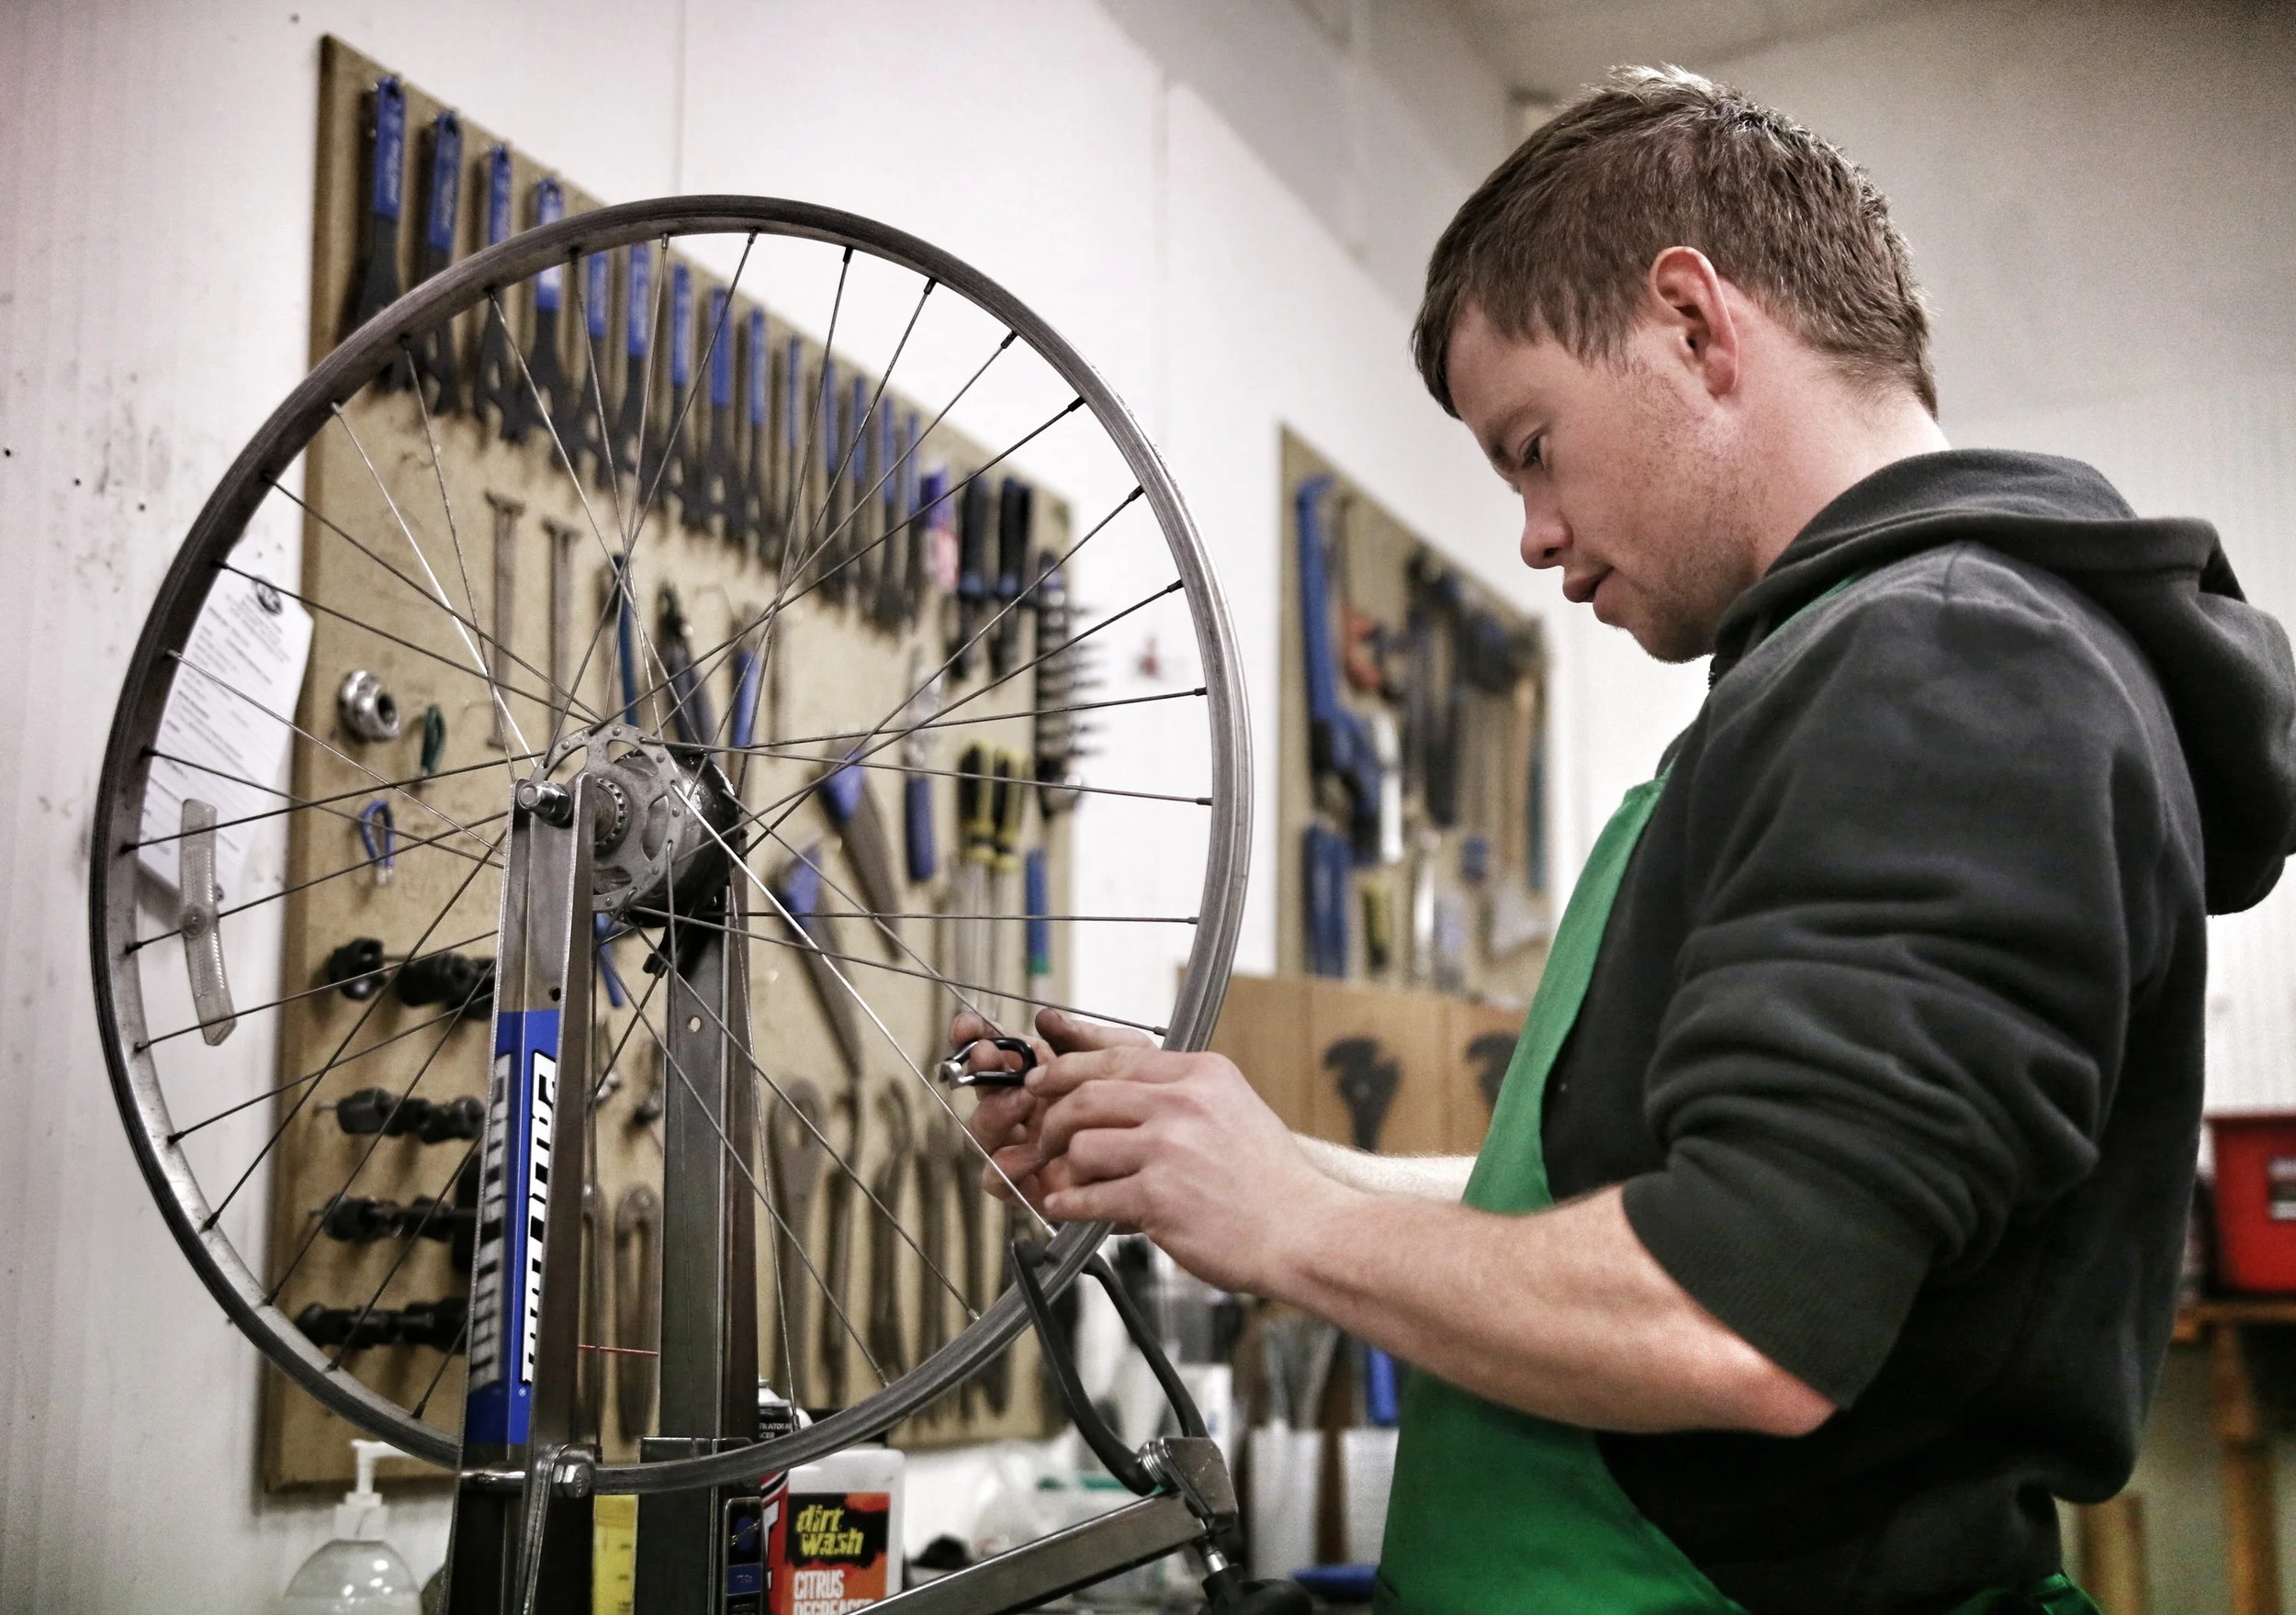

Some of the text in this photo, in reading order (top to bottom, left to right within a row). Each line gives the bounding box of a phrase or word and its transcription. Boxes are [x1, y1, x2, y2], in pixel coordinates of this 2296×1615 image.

[796, 1504, 845, 1532] dirt
[802, 1527, 864, 1556] wash
[793, 1569, 845, 1600] CITRUS
